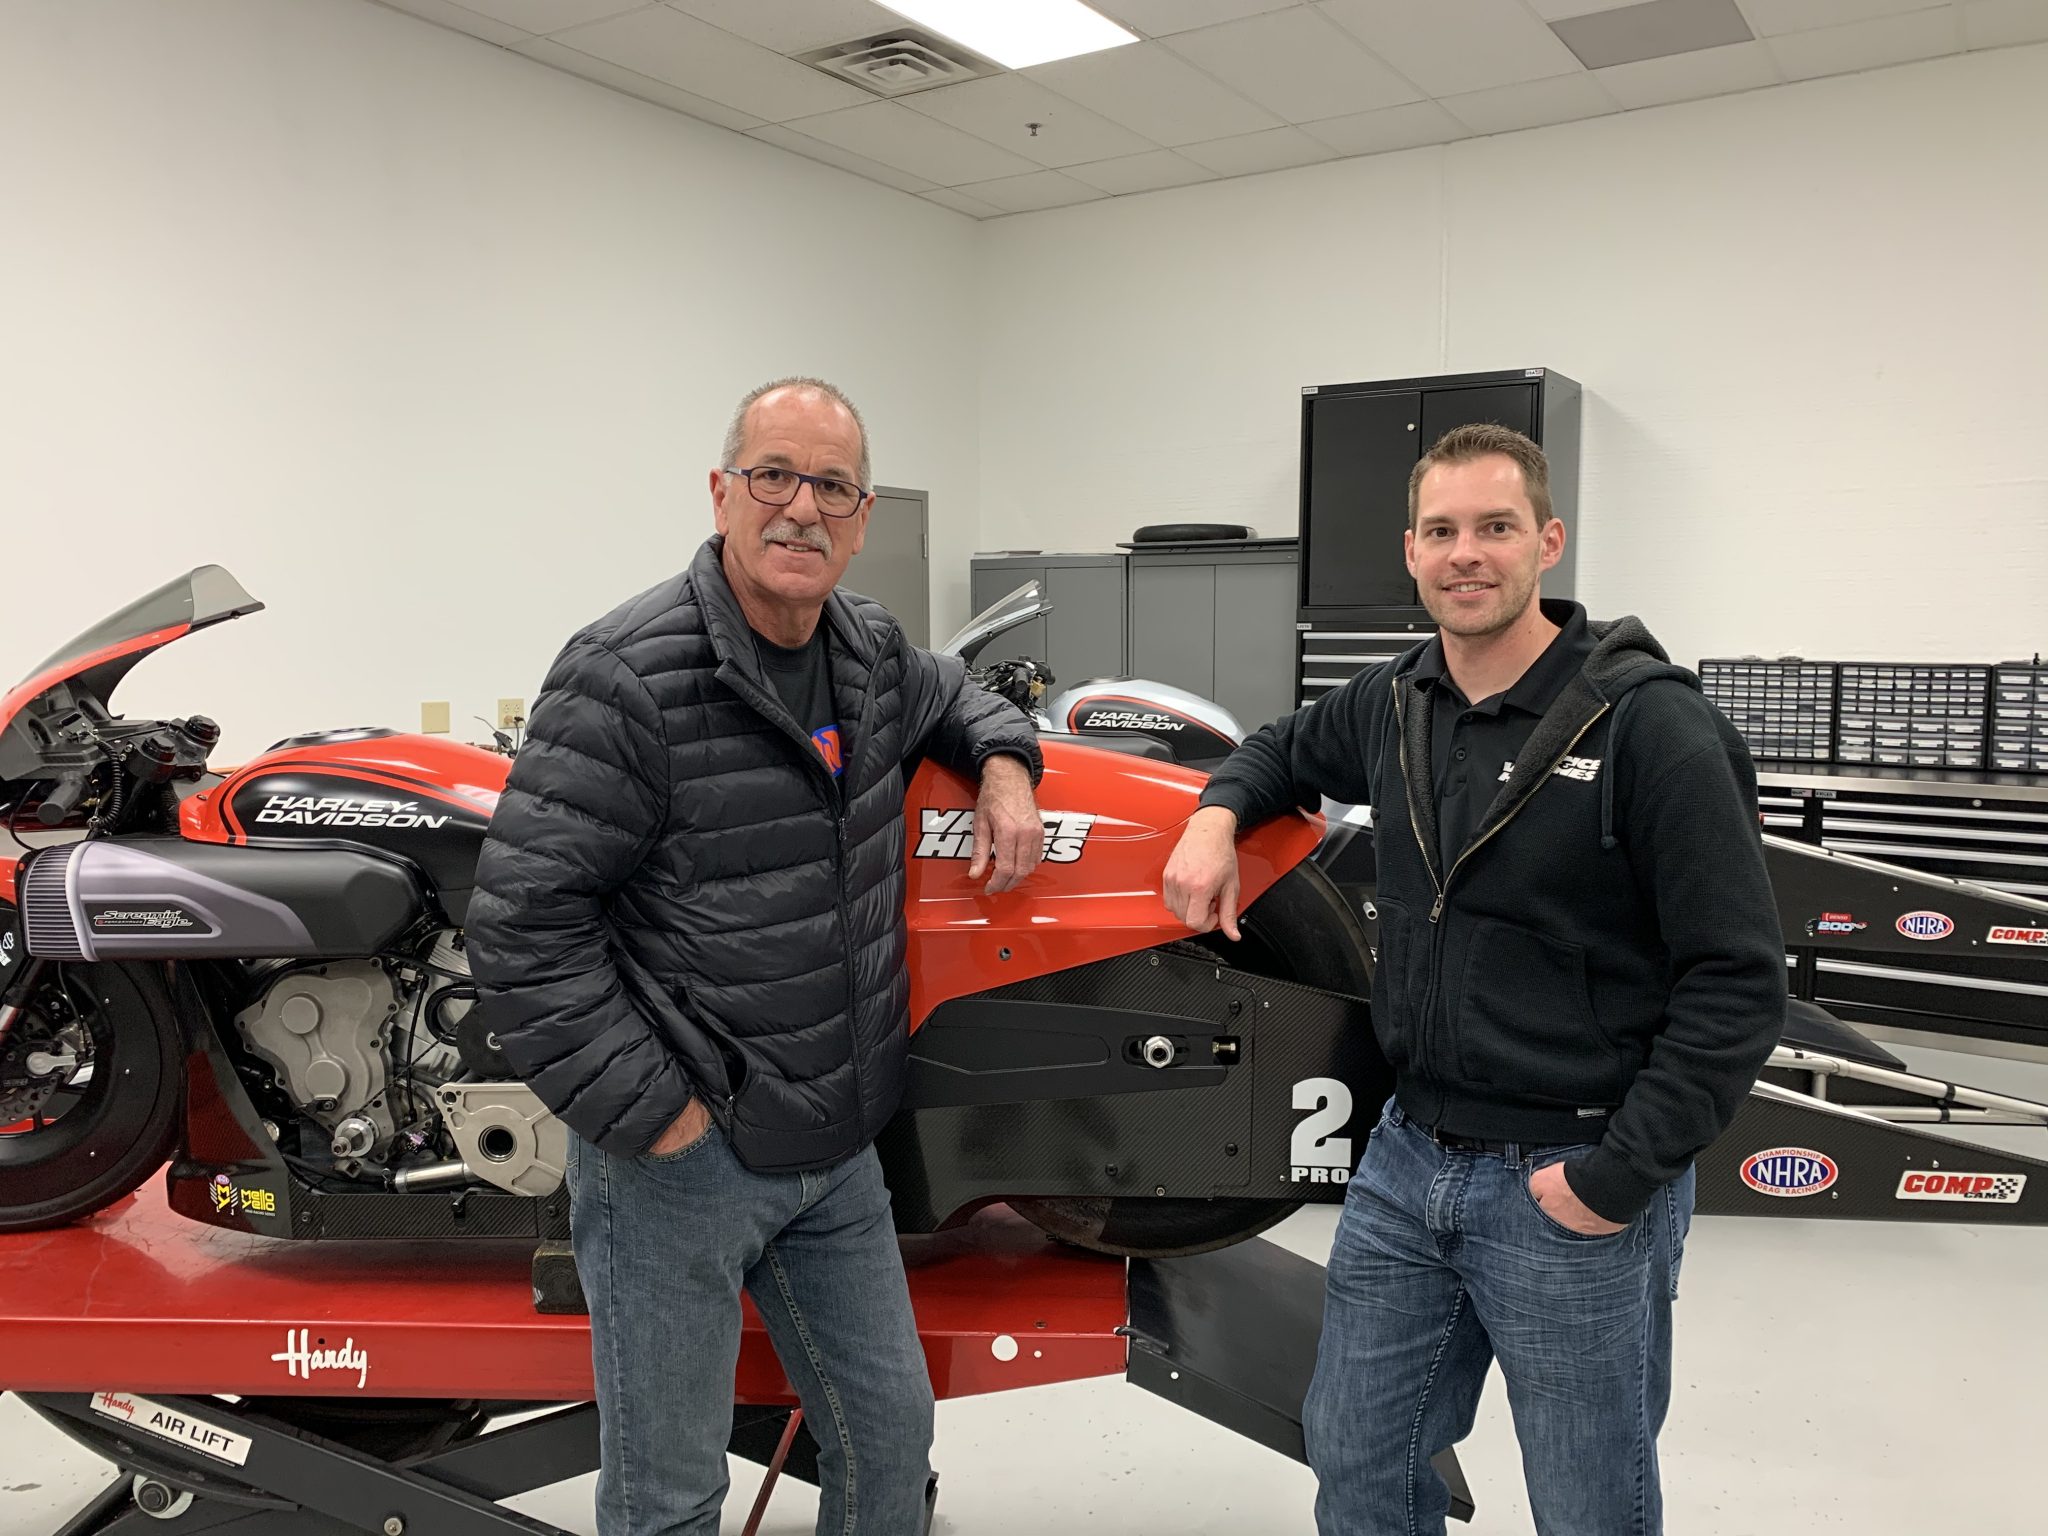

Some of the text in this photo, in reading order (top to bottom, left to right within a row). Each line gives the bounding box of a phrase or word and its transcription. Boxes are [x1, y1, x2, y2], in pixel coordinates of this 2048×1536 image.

[1084, 719, 1185, 731] DAVIDSON
[1090, 711, 1170, 722] HARLEY-
[264, 795, 419, 813] HARLEY-
[255, 809, 450, 829] DAVIDSON
[143, 918, 194, 929] Eagle
[1817, 921, 1853, 932] 200
[1905, 917, 1945, 934] NHRA
[1991, 928, 2044, 942] COMP
[1290, 1077, 1353, 1168] 2
[1757, 1149, 1821, 1160] CHAMPIONSHIP
[1291, 1167, 1350, 1184] PRO
[1757, 1157, 1823, 1187] NHRA
[1757, 1182, 1819, 1195] DRAG RACING
[1904, 1174, 1994, 1194] COMP
[1963, 1191, 2008, 1200] CAMS
[271, 1328, 368, 1389] Handy
[98, 1392, 135, 1419] Handy
[150, 1412, 186, 1435] AIR
[189, 1425, 234, 1452] LIFT
